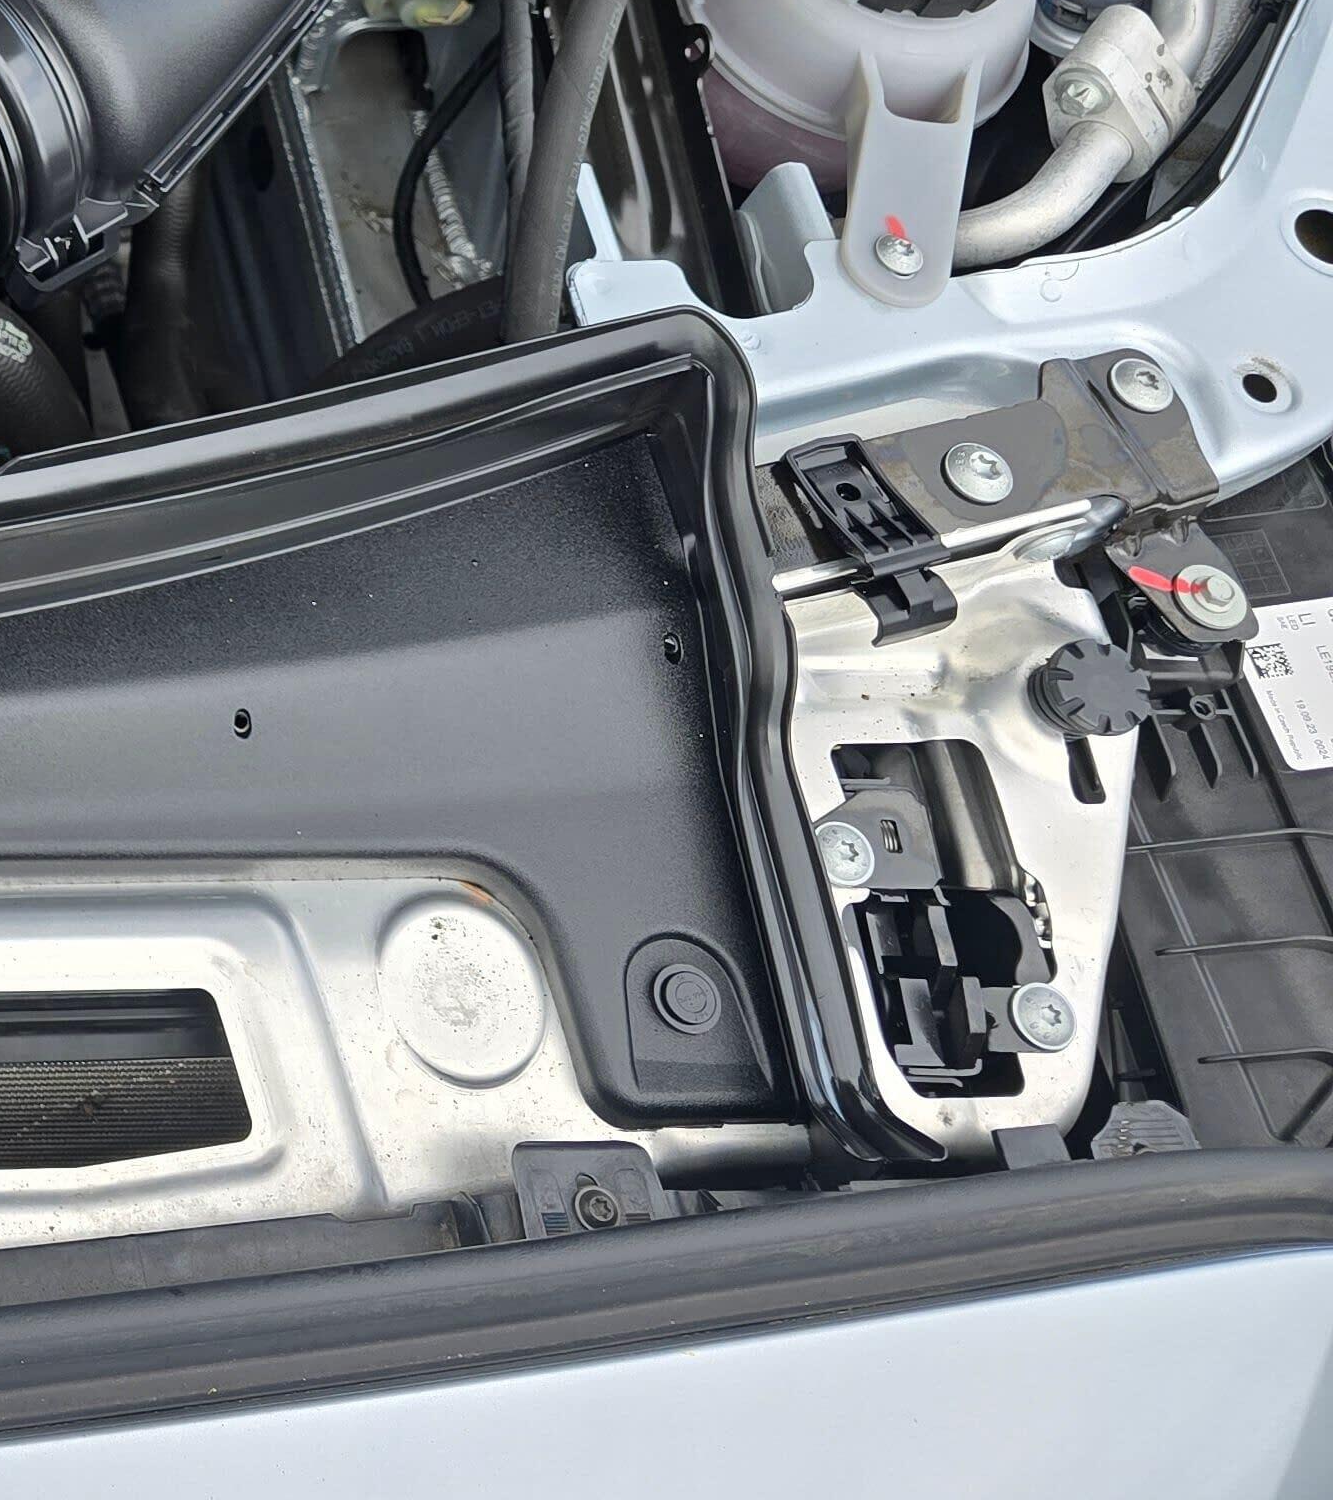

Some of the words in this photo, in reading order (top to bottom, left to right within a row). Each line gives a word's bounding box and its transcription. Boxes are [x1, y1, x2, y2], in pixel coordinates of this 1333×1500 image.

[1286, 614, 1299, 631] LED
[1298, 612, 1316, 626] LI
[1266, 690, 1277, 709] Made
